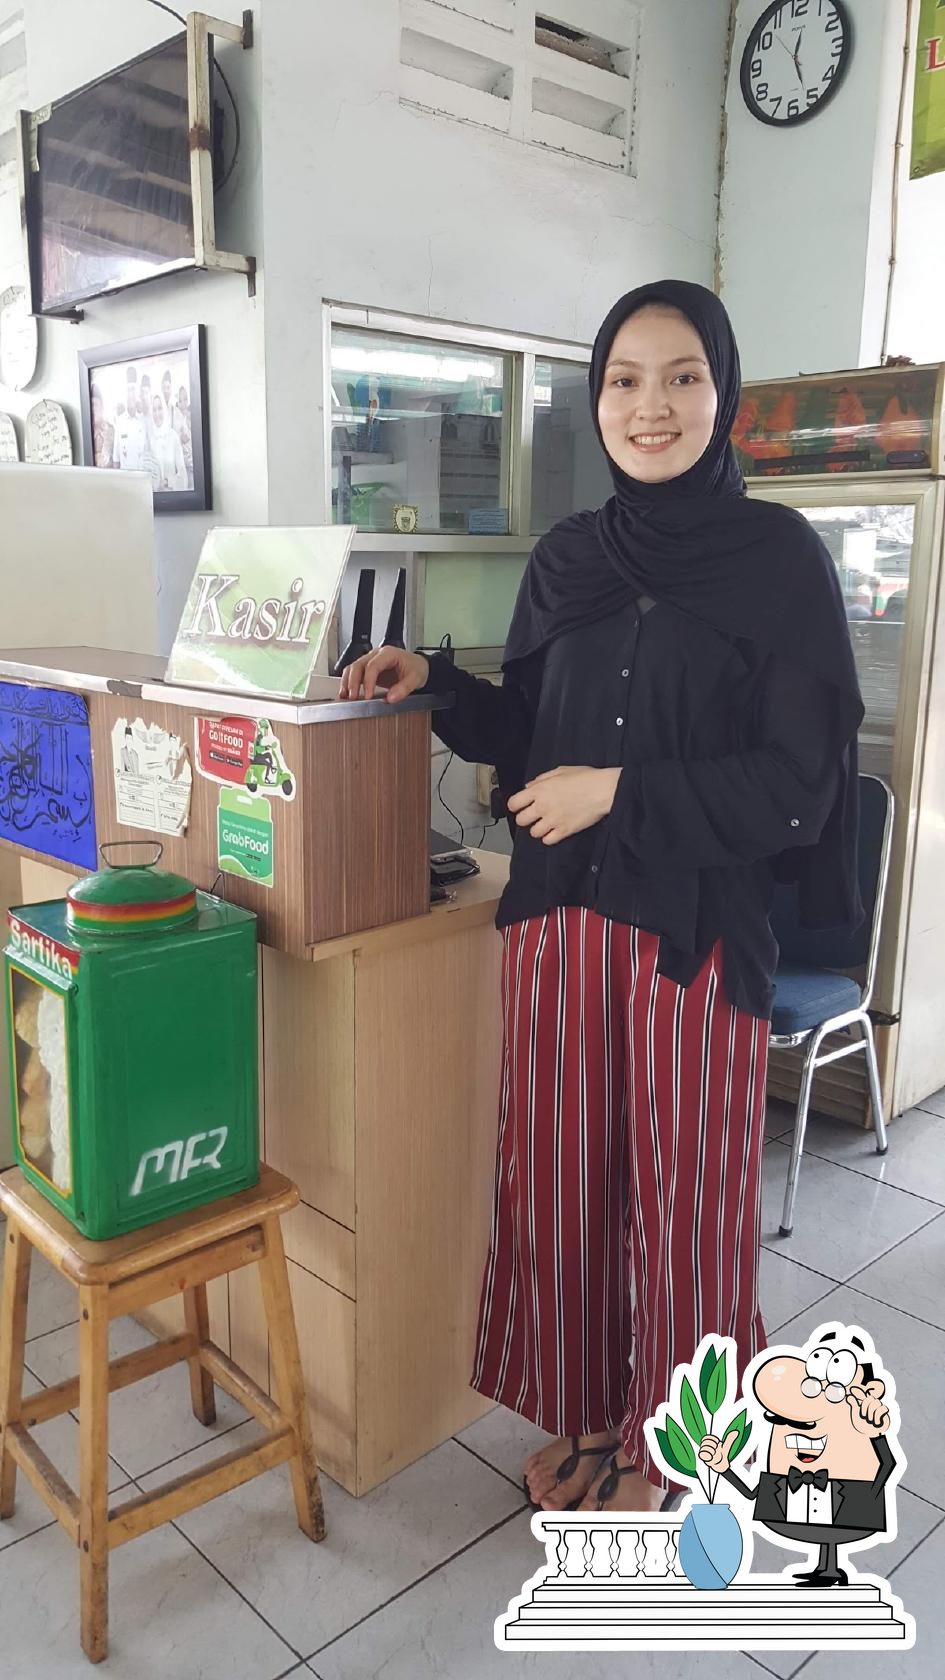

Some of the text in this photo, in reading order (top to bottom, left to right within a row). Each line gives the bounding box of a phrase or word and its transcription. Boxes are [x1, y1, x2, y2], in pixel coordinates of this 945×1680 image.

[773, 7, 783, 29] 11
[790, 0, 809, 18] 12
[825, 11, 841, 32] 2
[757, 31, 773, 52] 10
[831, 36, 843, 57] 3
[751, 59, 762, 79] 9
[822, 65, 836, 82] 4
[755, 83, 768, 101] 8
[806, 87, 819, 107] 5
[769, 96, 782, 117] 7
[787, 98, 799, 118] 6
[183, 573, 326, 645] Kasir
[223, 733, 244, 748] FOOD
[222, 829, 269, 855] GrabFood
[10, 918, 73, 981] Sartika
